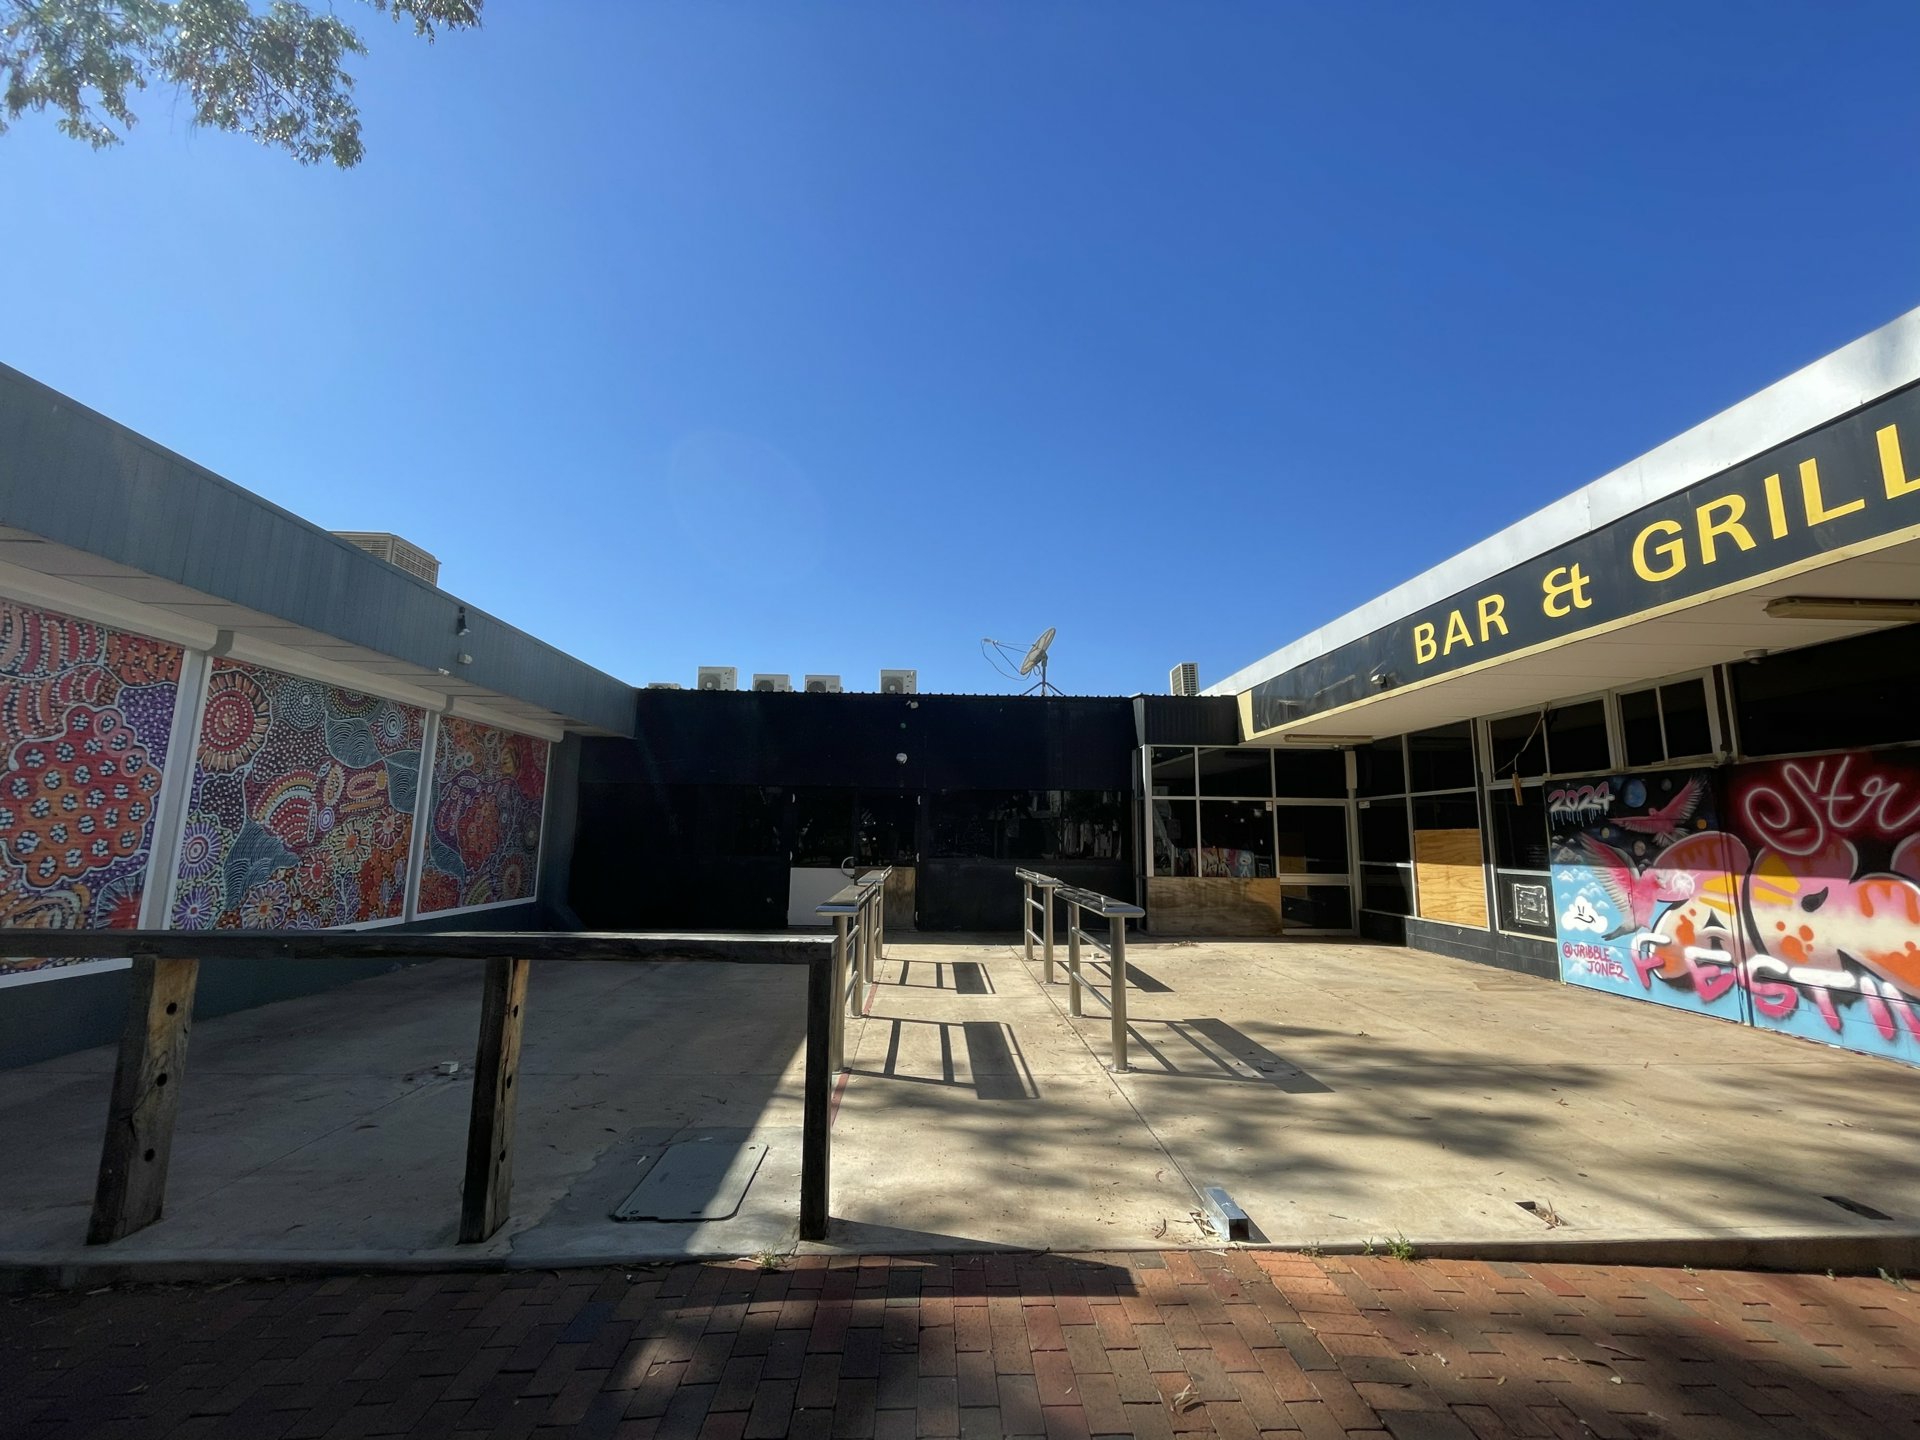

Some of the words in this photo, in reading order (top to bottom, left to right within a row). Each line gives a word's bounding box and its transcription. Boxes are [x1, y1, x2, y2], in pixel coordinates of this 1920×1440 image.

[1413, 594, 1510, 665] BAR
[1542, 562, 1593, 619] &
[1632, 423, 1920, 582] GRILL
[1547, 781, 1616, 813] 2024
